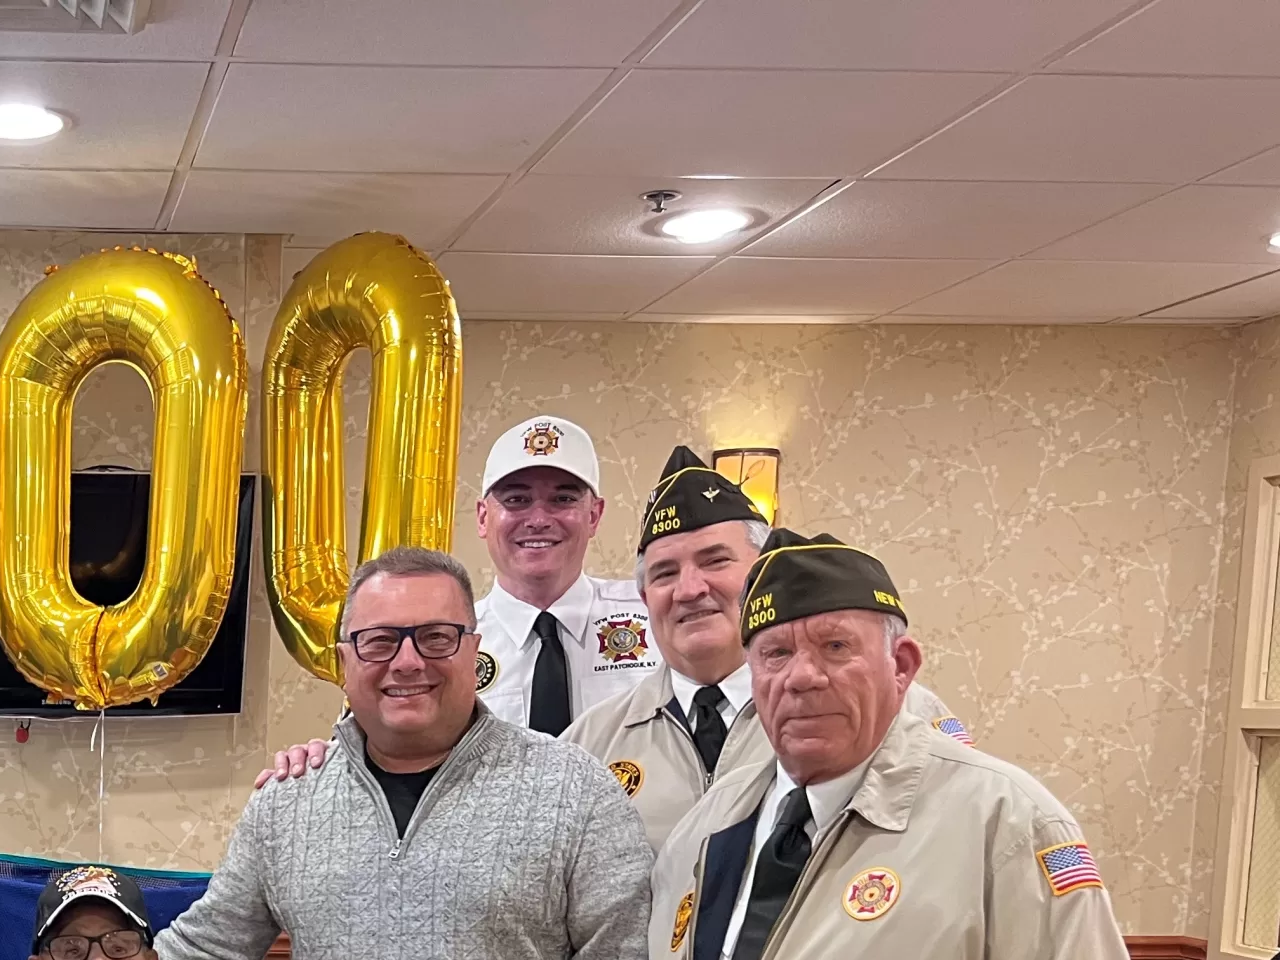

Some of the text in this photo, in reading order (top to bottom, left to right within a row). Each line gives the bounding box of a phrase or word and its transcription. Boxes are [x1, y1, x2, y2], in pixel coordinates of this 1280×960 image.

[654, 505, 676, 522] VFW
[651, 518, 681, 535] 8300
[750, 593, 773, 614] VFW
[593, 616, 608, 626] VFW
[610, 612, 630, 620] POST
[748, 608, 776, 630] 8300
